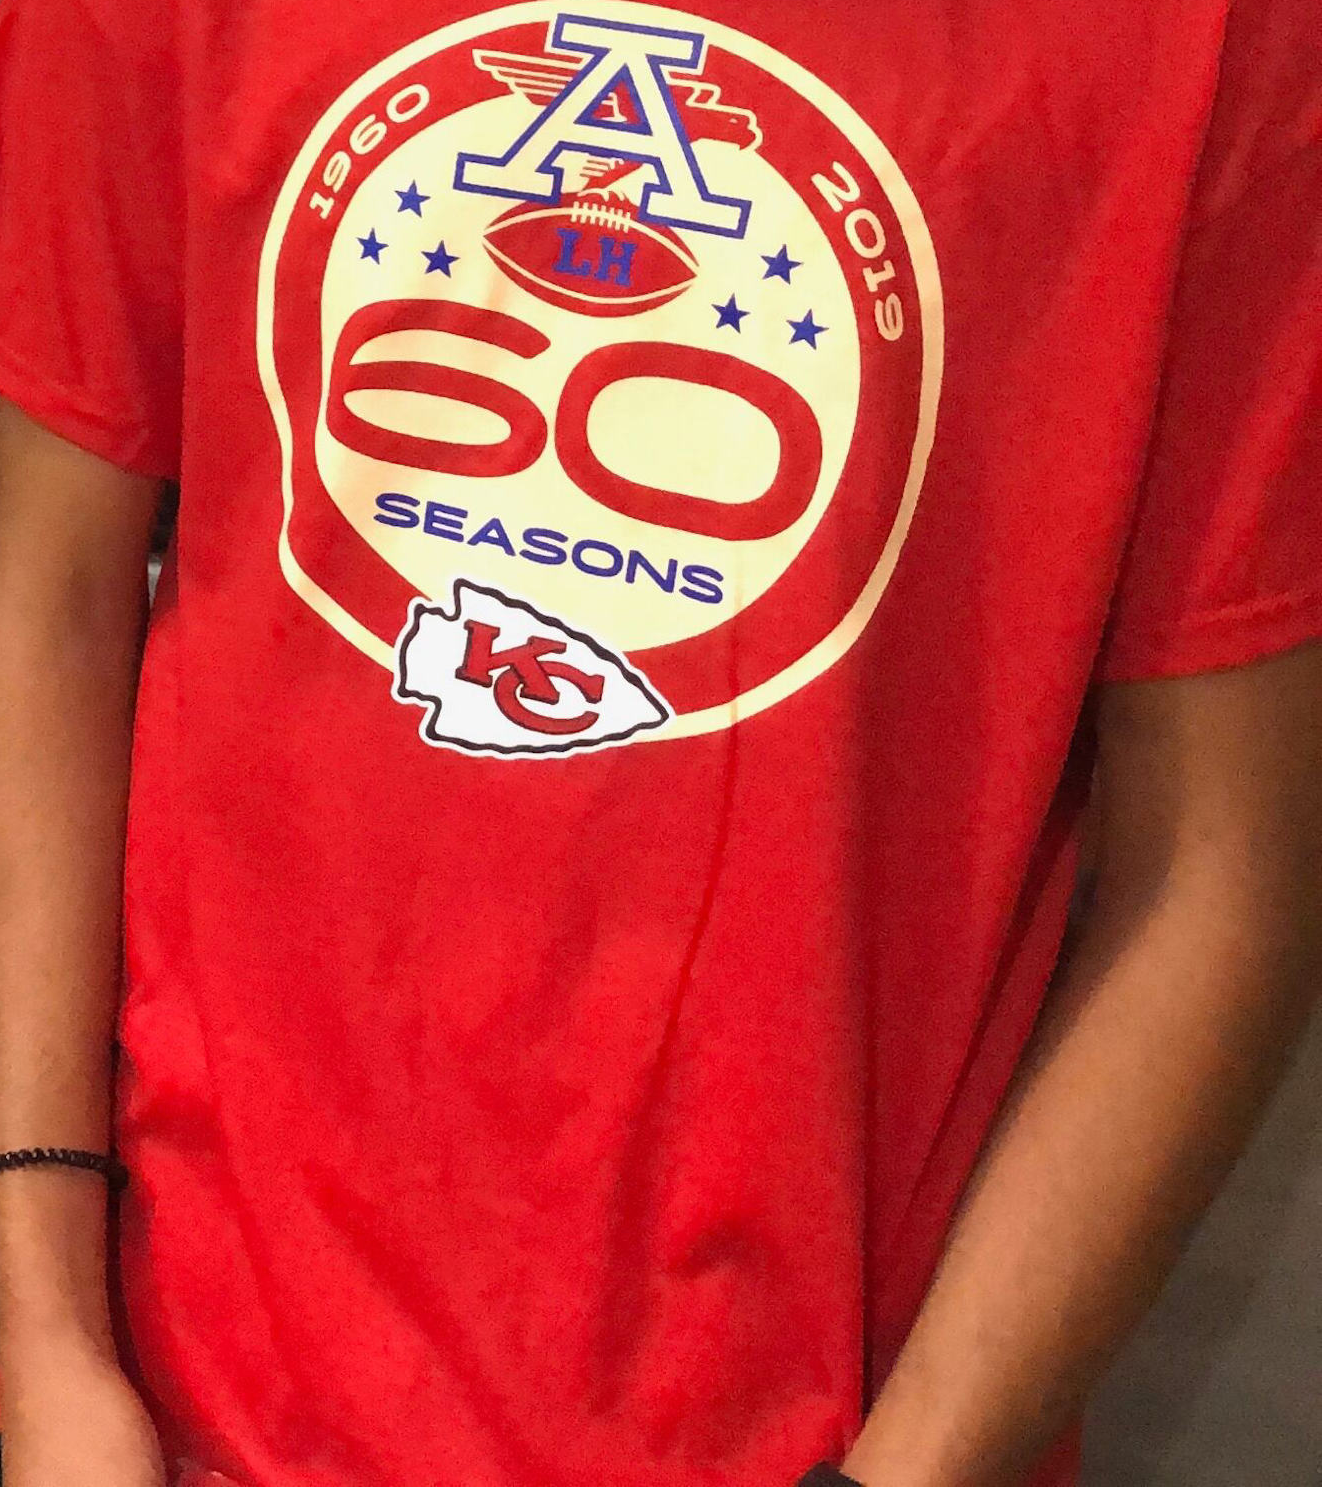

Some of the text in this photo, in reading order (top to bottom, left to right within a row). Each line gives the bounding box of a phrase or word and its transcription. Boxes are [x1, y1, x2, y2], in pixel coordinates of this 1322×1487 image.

[308, 82, 430, 220] 1960
[453, 13, 753, 239] A
[556, 227, 637, 288] LH
[810, 161, 905, 343] 2019
[326, 298, 824, 541] 60
[373, 492, 724, 604] SEASONS
[462, 619, 606, 735] KC
